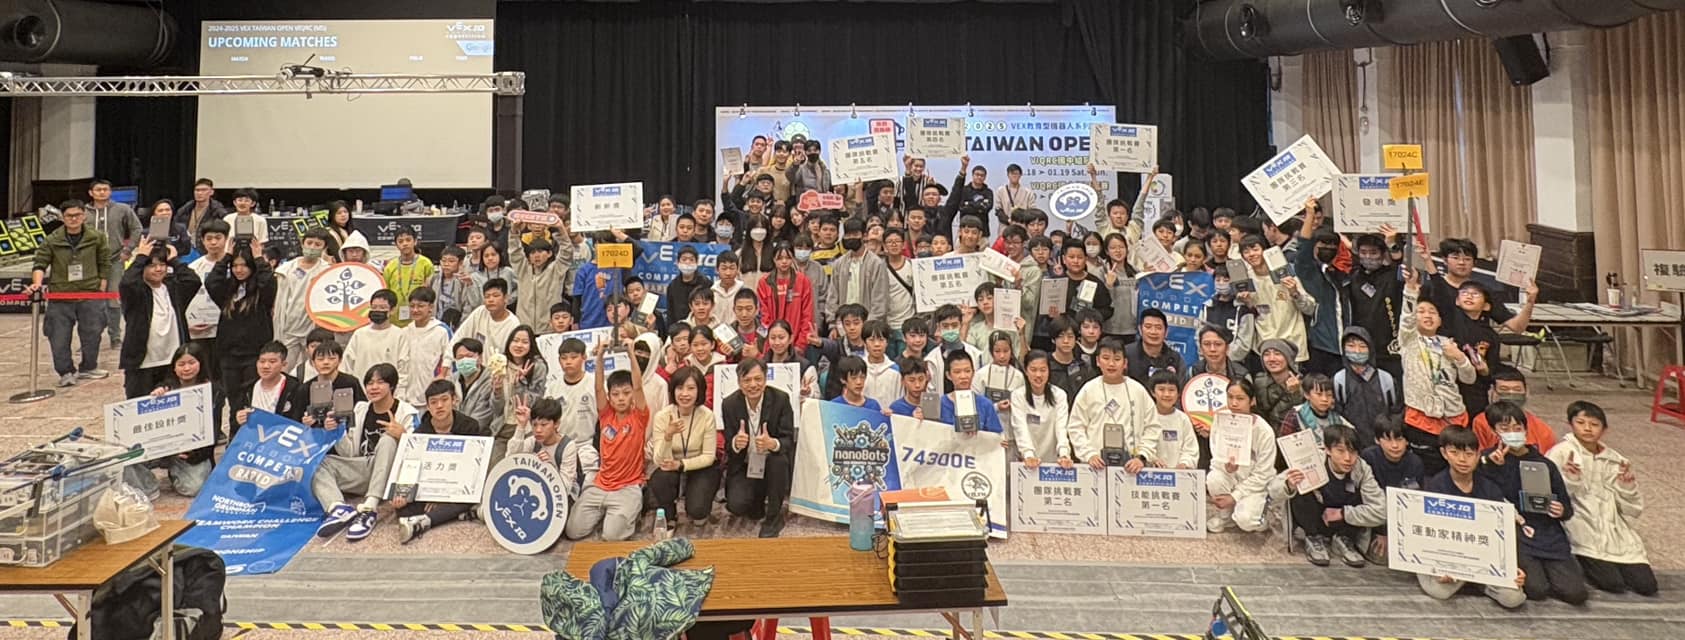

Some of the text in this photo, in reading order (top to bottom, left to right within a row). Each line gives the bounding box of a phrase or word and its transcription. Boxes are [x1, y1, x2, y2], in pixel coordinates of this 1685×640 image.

[208, 36, 337, 48] UPCOMING MATCHES
[965, 136, 1090, 151] TAIWAN OPE
[1047, 168, 1070, 177] 01.19
[1145, 273, 1209, 297] VEX
[1142, 299, 1198, 314] COMPET
[257, 424, 318, 458] VEX
[834, 449, 887, 462] nanoBots
[901, 446, 977, 470] 74300E
[237, 451, 293, 476] COMPET
[234, 468, 271, 485] RAPID
[512, 456, 564, 520] TAIWAN OPEN
[1034, 486, 1082, 497] 團隊挑戰賽
[1044, 497, 1073, 507] 第二名
[1131, 490, 1181, 501] 技能挑戰賽
[1141, 500, 1170, 511] 第一名
[1427, 498, 1456, 510] VEX
[256, 516, 320, 525] CHALLENGE
[494, 501, 517, 528] VEX
[220, 523, 281, 531] CHAMPION
[1411, 524, 1490, 546] 運動家精神獎
